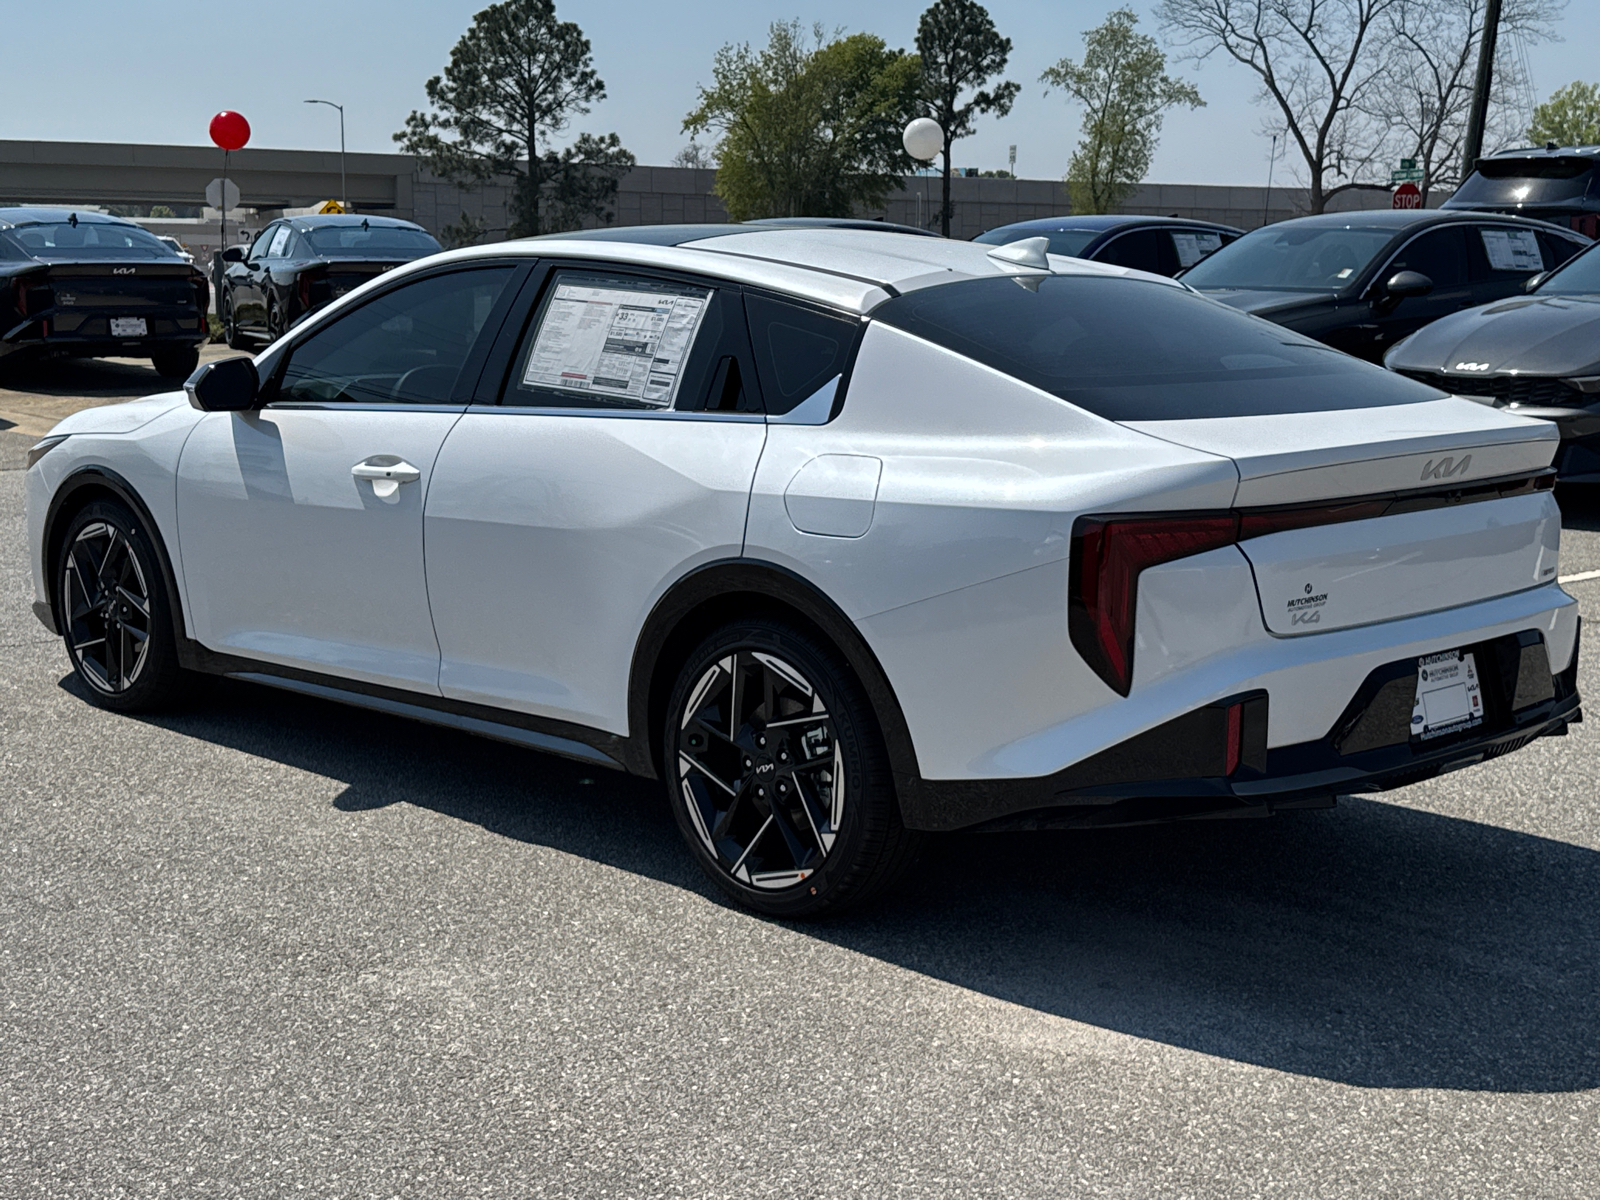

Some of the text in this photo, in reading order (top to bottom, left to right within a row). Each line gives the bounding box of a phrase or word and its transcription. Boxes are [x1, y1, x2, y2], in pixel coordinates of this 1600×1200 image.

[1394, 194, 1420, 209] STOP
[618, 312, 629, 321] 33
[1455, 362, 1490, 371] KIA
[1420, 454, 1472, 481] KIA
[1287, 593, 1328, 607] HUTCHINSON
[1291, 610, 1321, 626] K4
[755, 763, 774, 774] KIA
